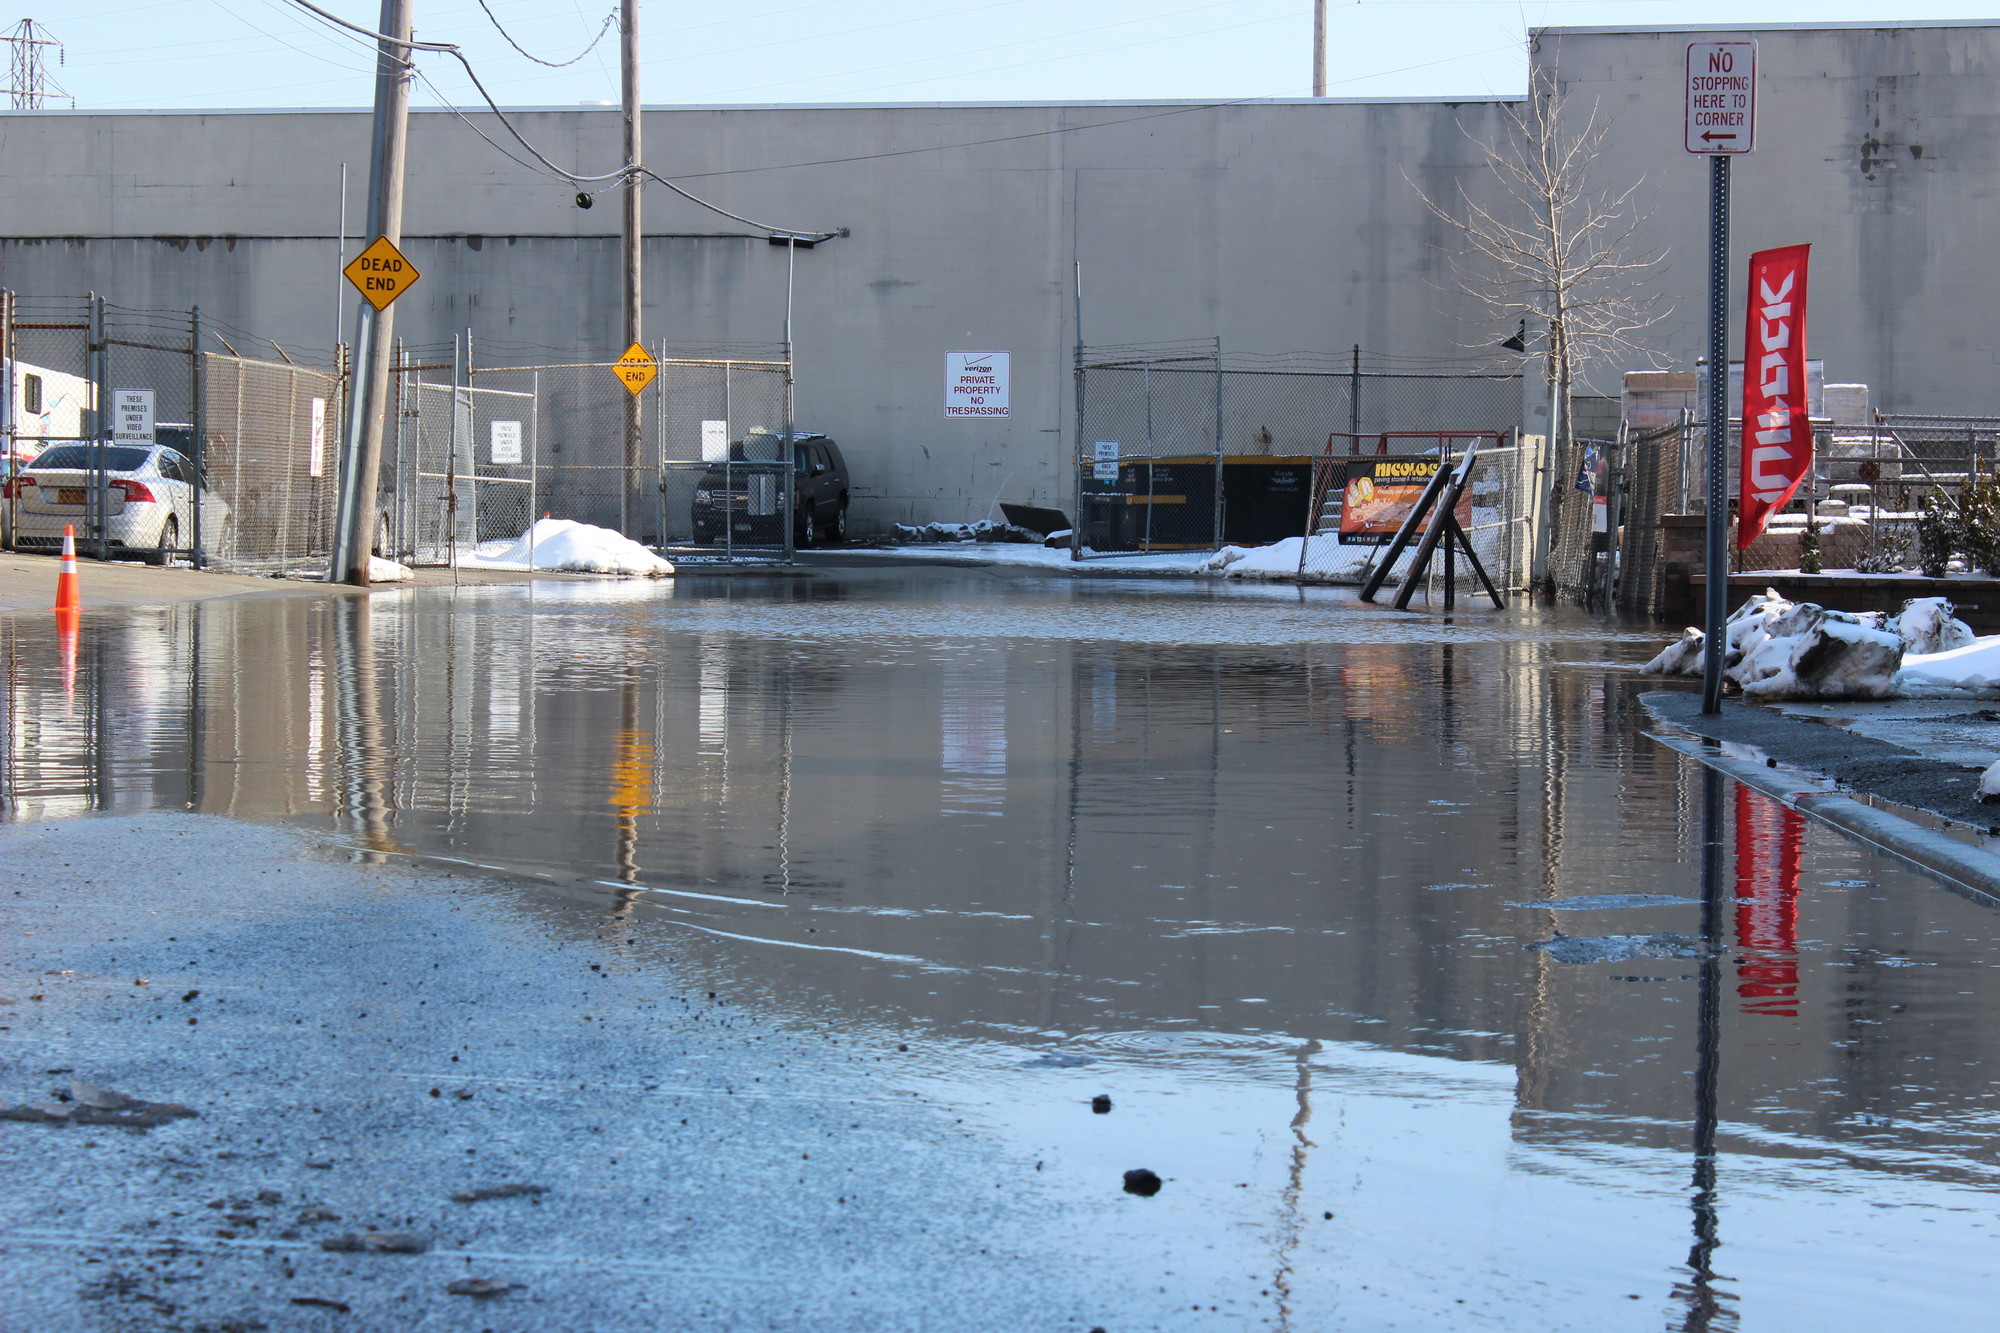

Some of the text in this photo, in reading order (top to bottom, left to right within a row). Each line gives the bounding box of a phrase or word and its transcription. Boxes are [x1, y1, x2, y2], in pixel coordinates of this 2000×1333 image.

[1708, 52, 1733, 73] NO
[1692, 76, 1749, 91] STOPPING
[1693, 94, 1746, 109] HERE TO
[1695, 112, 1744, 126] CORNER
[361, 257, 402, 272] DEAD
[366, 277, 396, 291] END
[622, 358, 649, 368] DEAD
[964, 365, 992, 373] verizon
[626, 371, 645, 381] END
[960, 376, 995, 384] PRIVATE
[953, 386, 1001, 394] PROPERTY
[126, 395, 143, 403] THESE
[970, 396, 984, 405] NO
[121, 404, 148, 412] PREMISES
[946, 406, 1009, 415] TRESPASSING
[126, 423, 142, 431] VIDEO
[115, 432, 153, 440] SURVEILLANCE
[1375, 463, 1439, 477] NICOLOC
